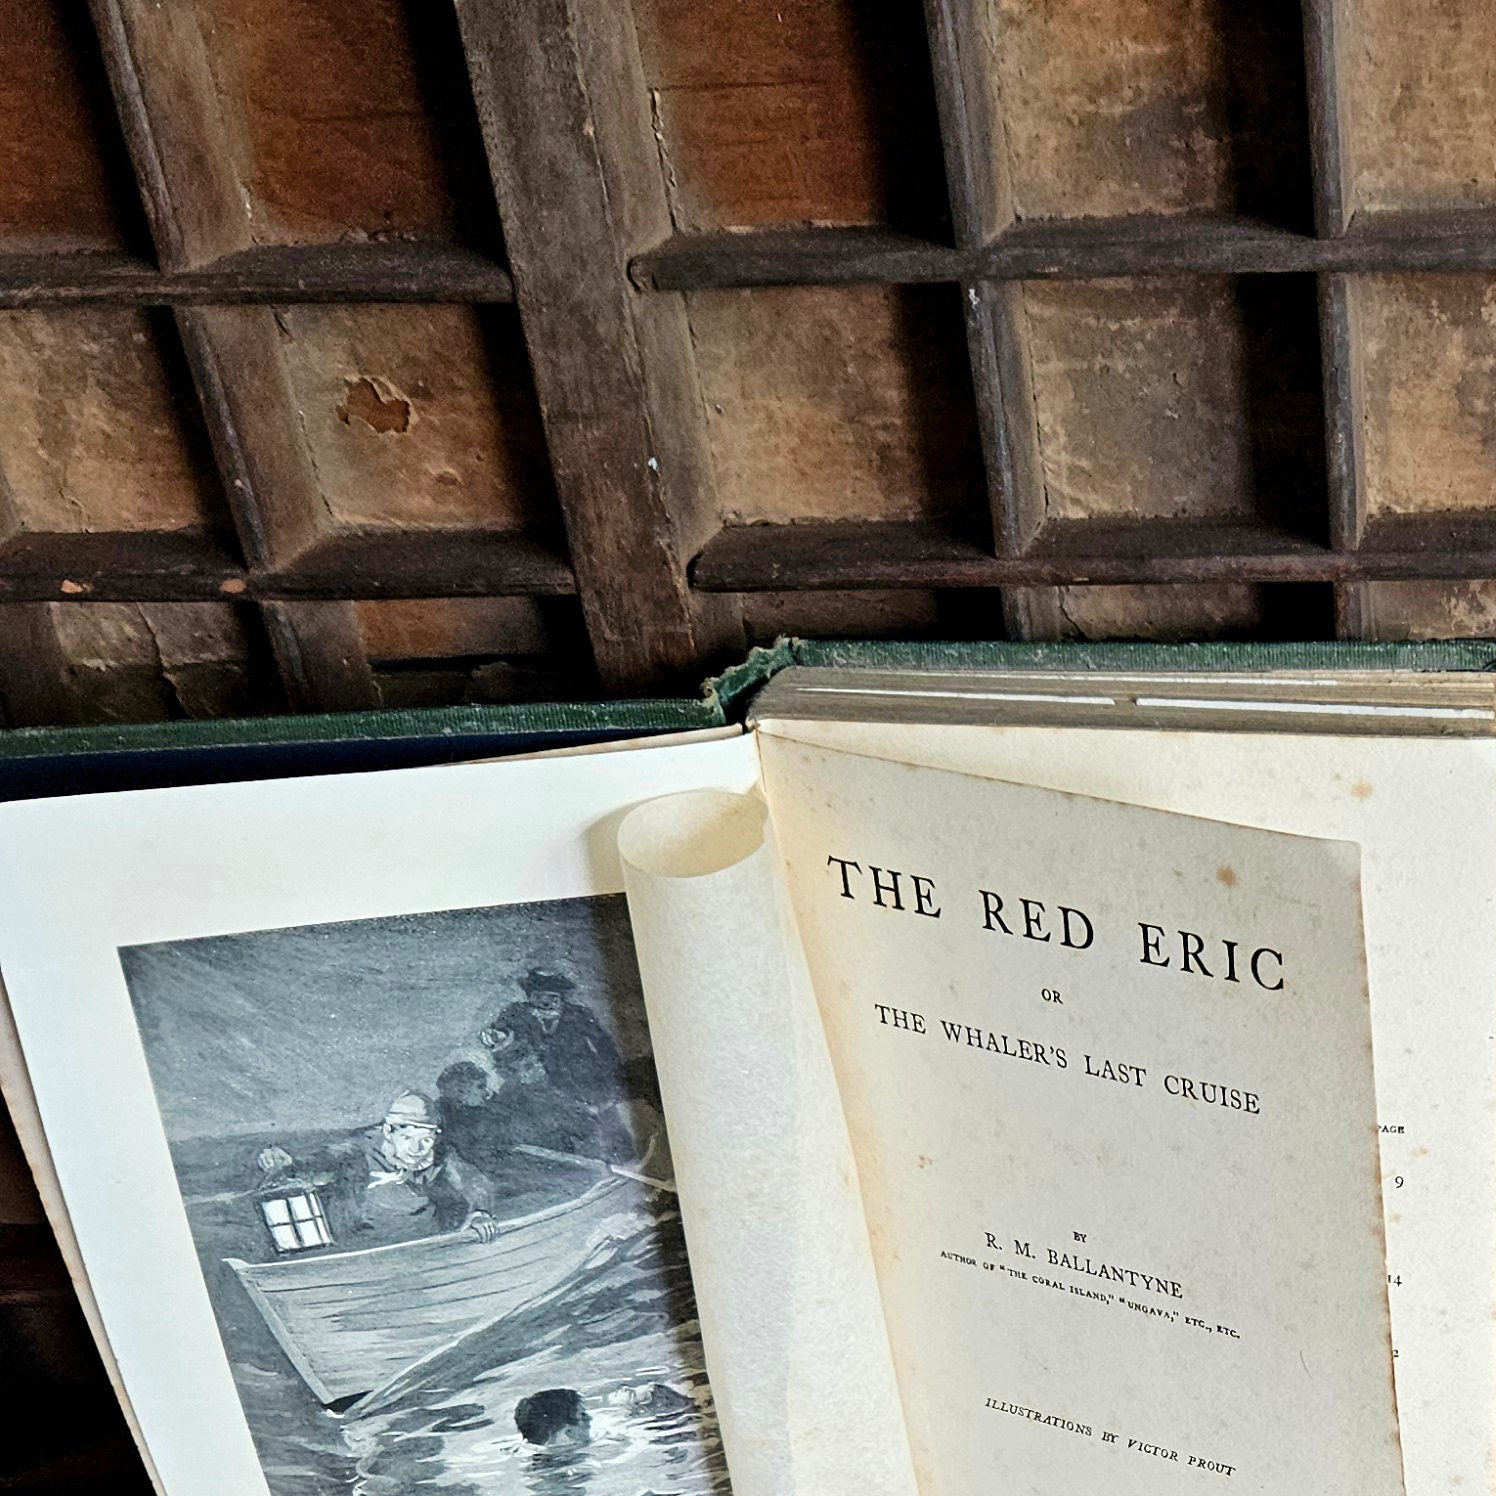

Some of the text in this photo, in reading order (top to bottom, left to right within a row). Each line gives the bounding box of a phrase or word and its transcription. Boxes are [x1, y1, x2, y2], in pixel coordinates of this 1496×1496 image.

[827, 856, 1283, 990] THE RED ERIC
[1041, 989, 1063, 1004] OR
[875, 1004, 1260, 1114] THE WHALER'S LAST CRUISE
[1395, 1176, 1403, 1188] 9
[985, 1232, 1182, 1301] R. M. BALLANTYNE
[1073, 1232, 1086, 1243] BY
[941, 1251, 976, 1266] AUTHOR
[1032, 1276, 1065, 1290] CORAL
[1185, 1317, 1212, 1333] ETC.,
[1217, 1325, 1240, 1339] ETC.
[985, 1398, 1236, 1476] ILLUSTRATIONS BY VICTOR PROUT
